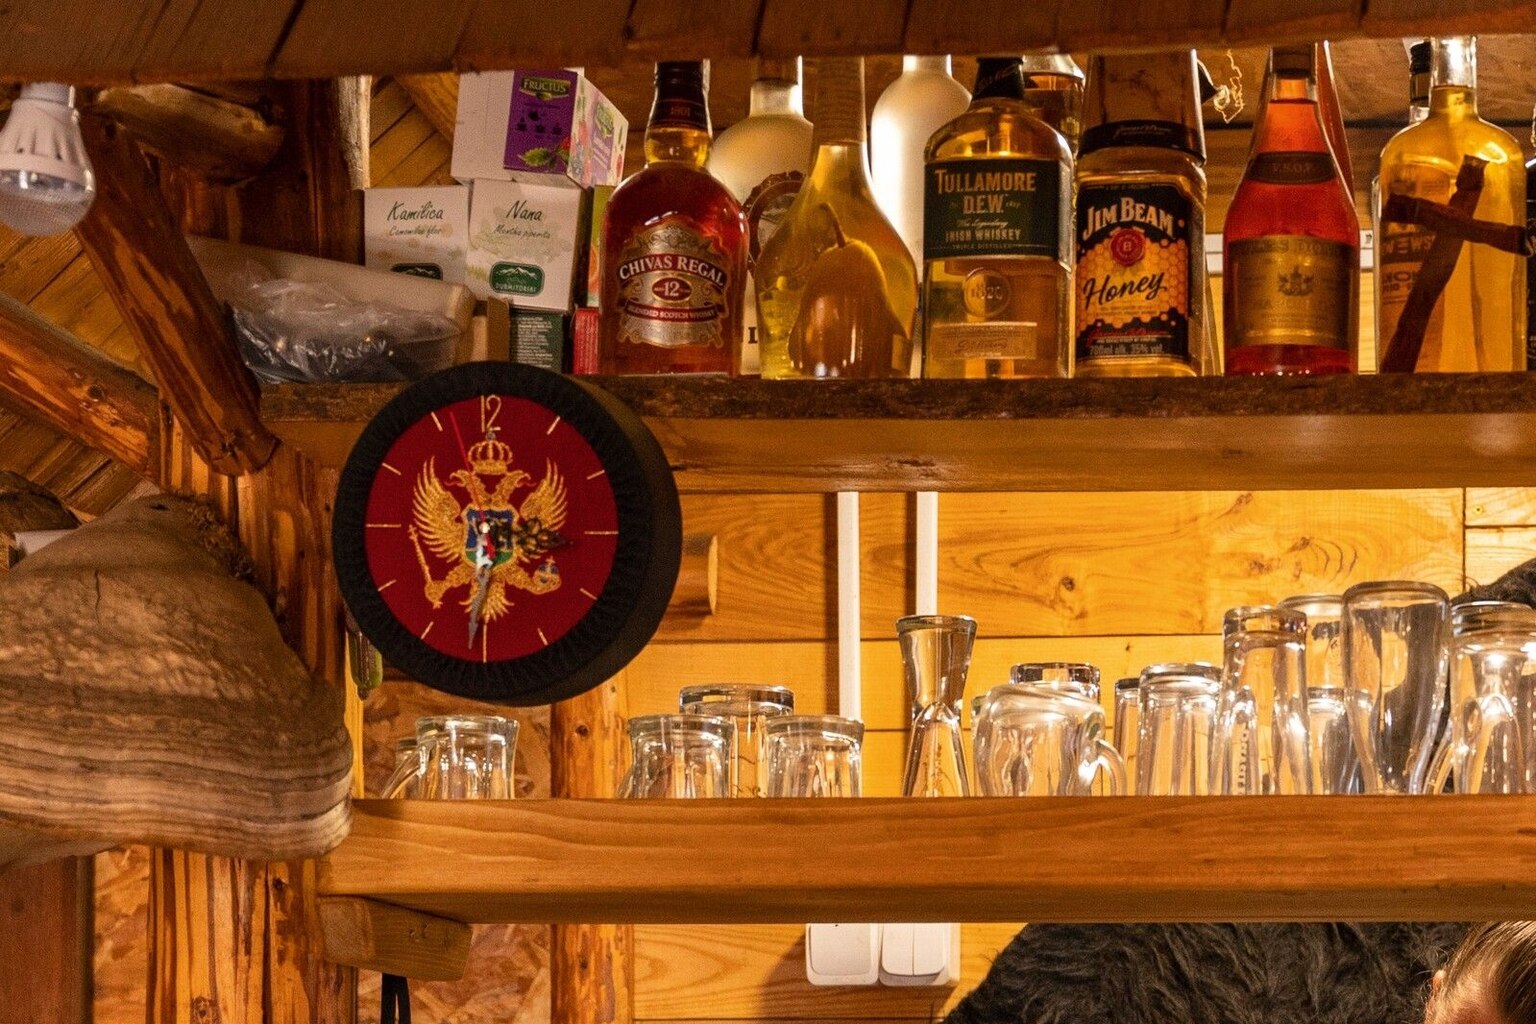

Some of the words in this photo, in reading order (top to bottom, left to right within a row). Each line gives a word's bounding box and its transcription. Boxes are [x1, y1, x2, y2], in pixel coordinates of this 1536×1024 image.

[523, 78, 567, 94] FRUCTUS
[935, 169, 1037, 195] TULLAMORE
[387, 201, 444, 221] Kamilica
[506, 200, 543, 222] Nana
[1083, 204, 1118, 241] JIM
[1120, 197, 1174, 241] BEAM
[945, 230, 972, 243] IRISH
[975, 228, 1022, 241] WHISKEY
[619, 254, 673, 280] CHIVAS
[677, 255, 725, 287] REGAL
[664, 280, 681, 297] 12
[1082, 272, 1168, 311] Honey
[627, 305, 659, 318] BLENDED
[659, 310, 689, 319] SCOTCH
[480, 394, 502, 433] 12
